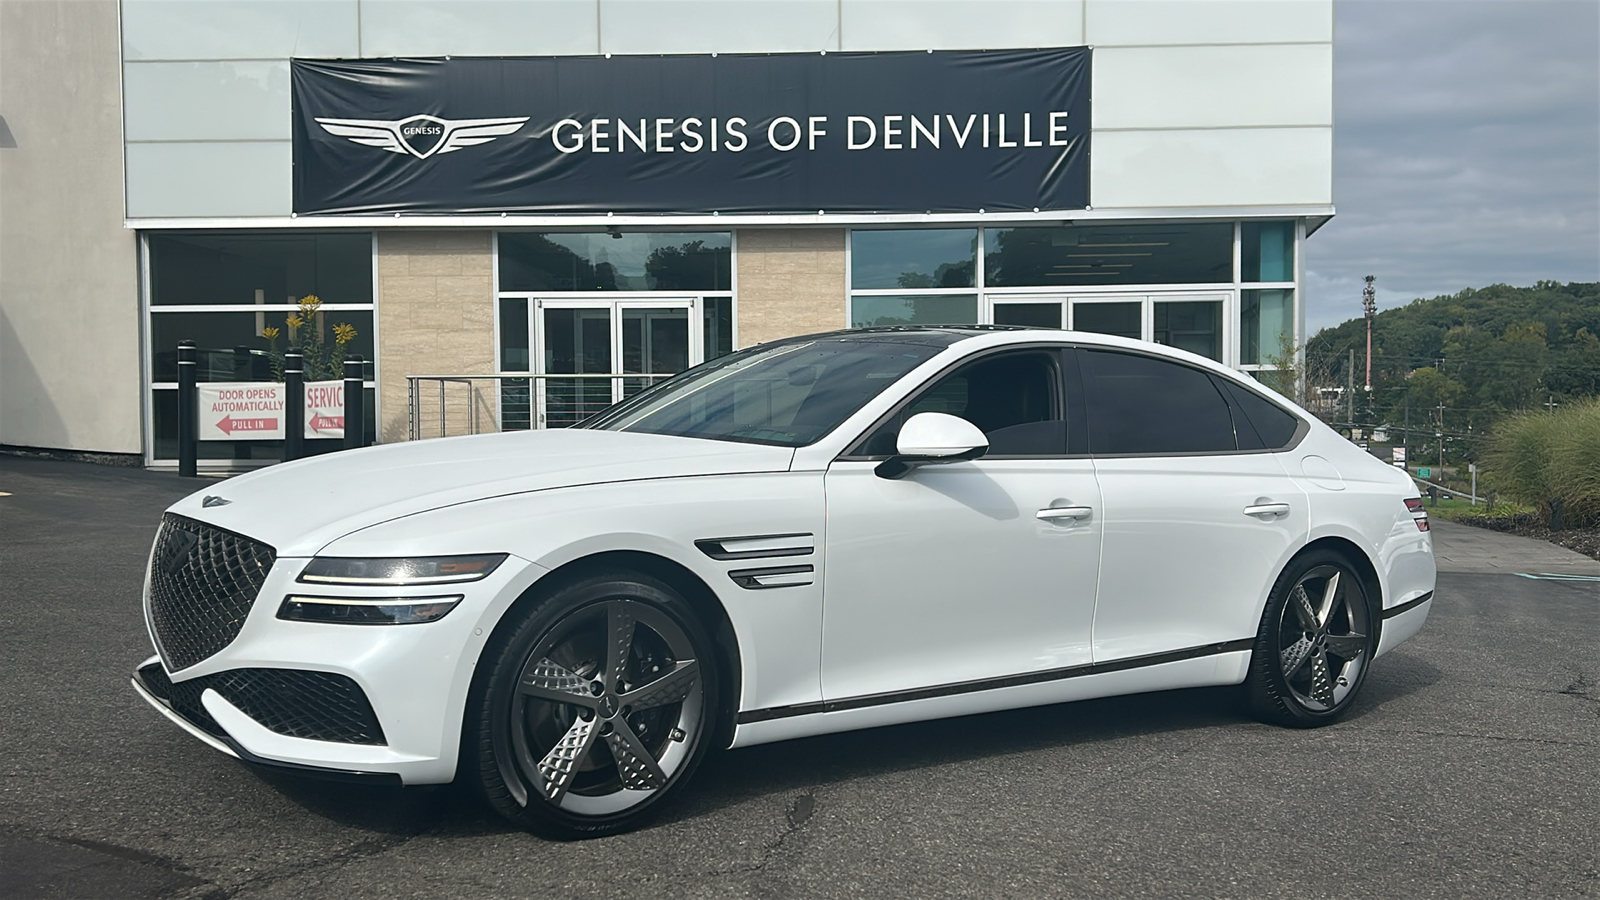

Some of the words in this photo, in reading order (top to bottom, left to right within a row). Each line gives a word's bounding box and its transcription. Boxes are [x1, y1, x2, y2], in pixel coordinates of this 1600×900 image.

[403, 126, 441, 135] GENESIS
[551, 116, 748, 154] GENESIS
[767, 116, 827, 152] OF
[847, 111, 1068, 150] DENVILLE
[219, 390, 244, 400] DOOR
[246, 389, 276, 399] OPENS
[307, 386, 344, 408] SERVIC
[212, 400, 284, 412] AUTOMATICALLY
[232, 420, 252, 429] PULL
[255, 420, 264, 429] IN
[318, 418, 331, 427] PULL
